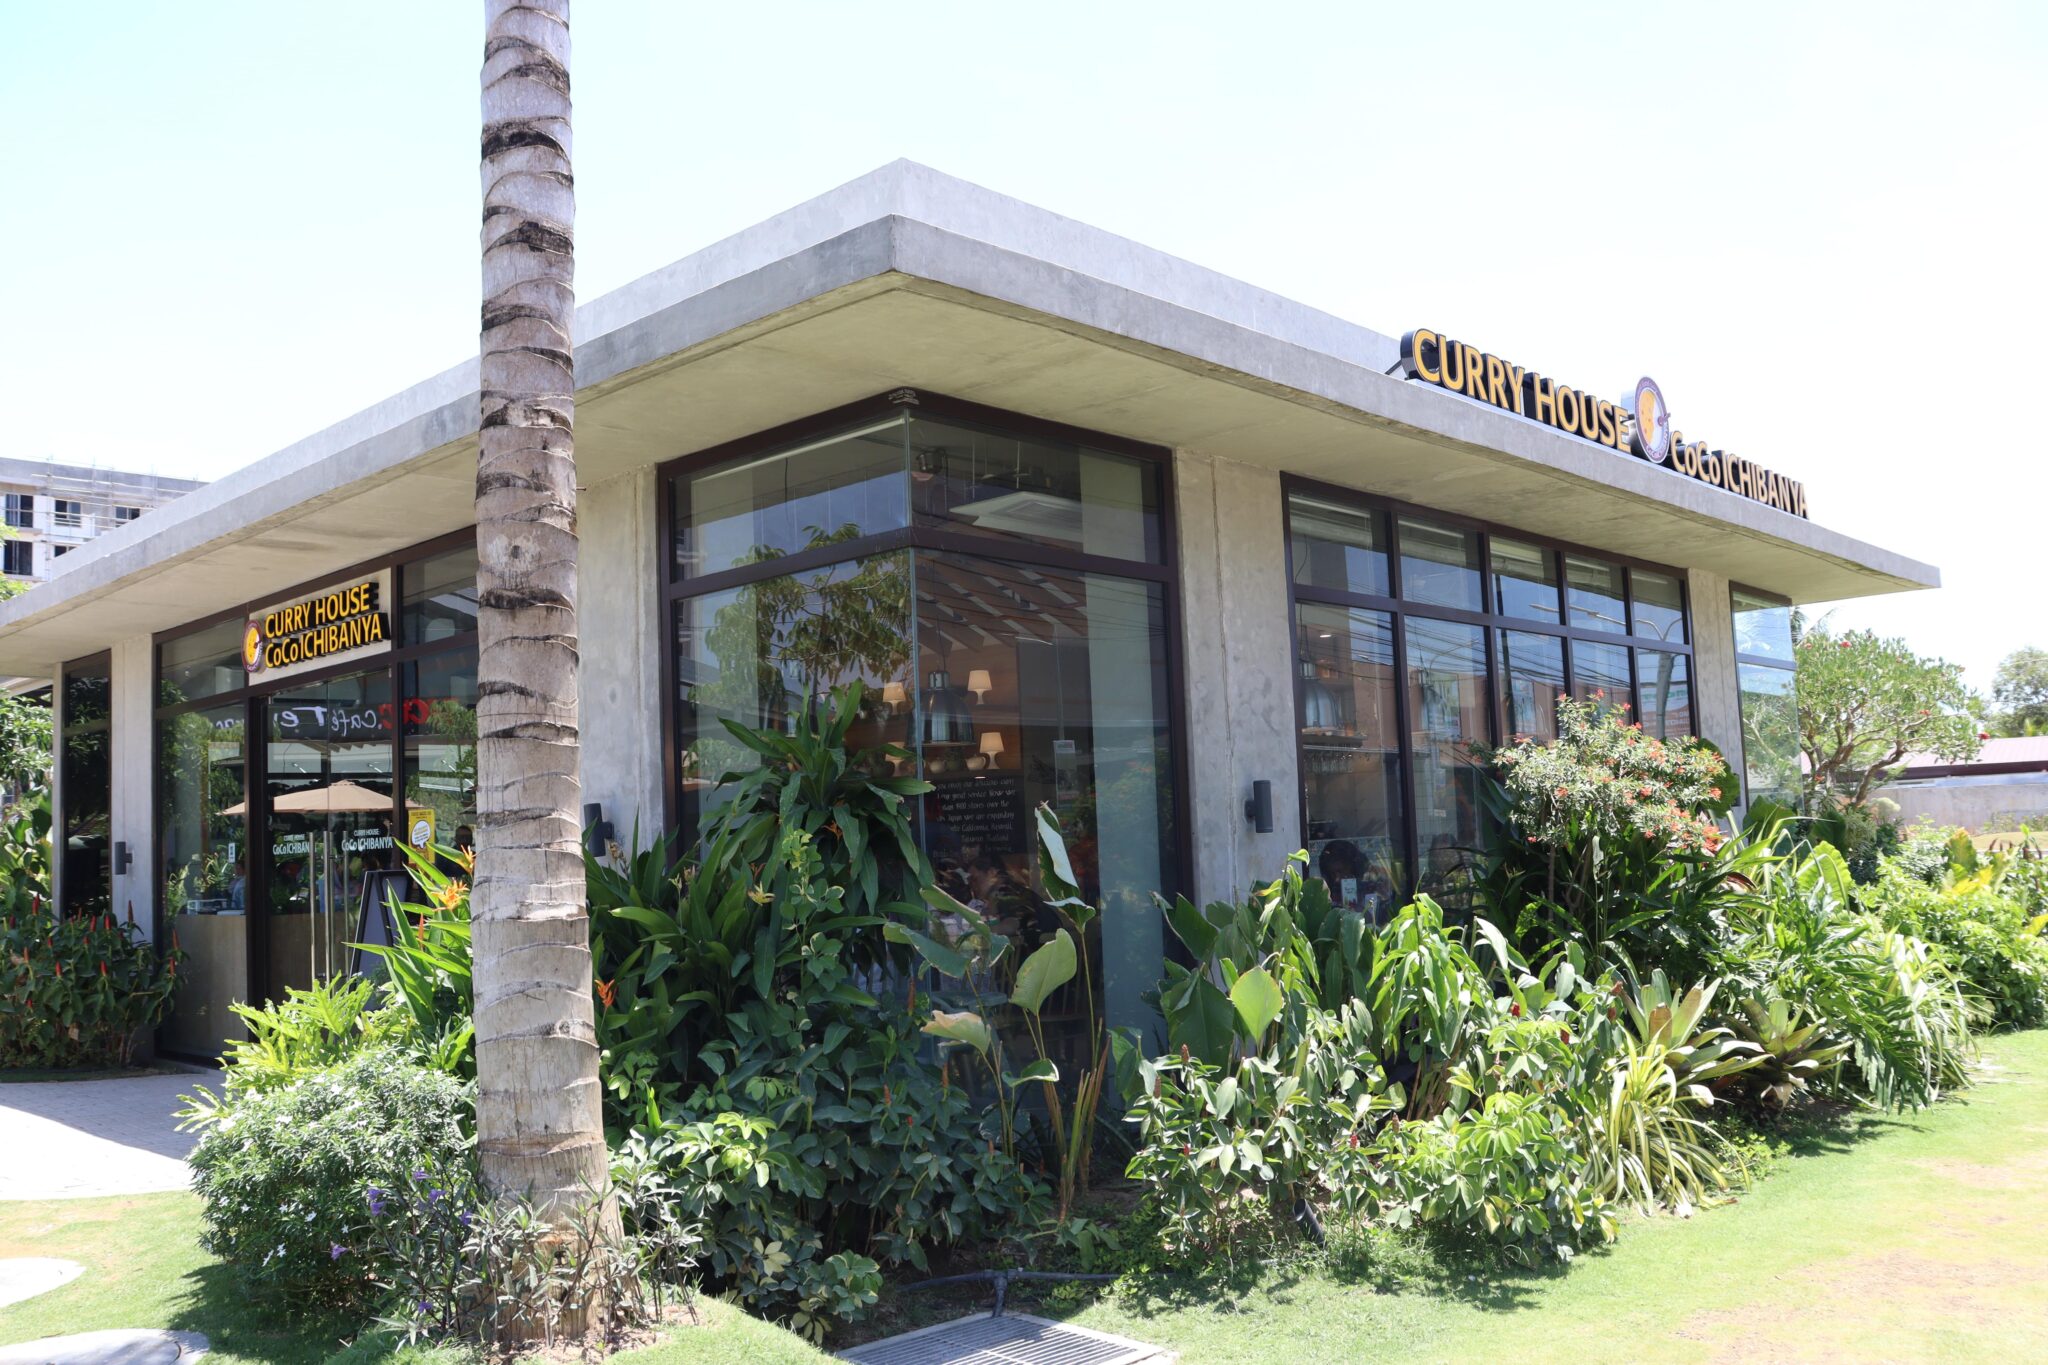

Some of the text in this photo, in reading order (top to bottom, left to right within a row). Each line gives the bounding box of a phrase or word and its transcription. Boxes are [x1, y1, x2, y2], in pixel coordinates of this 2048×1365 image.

[1411, 327, 1526, 415] CURRY
[1533, 371, 1632, 453] HOUSE
[265, 582, 370, 639] CURRY HOUSE
